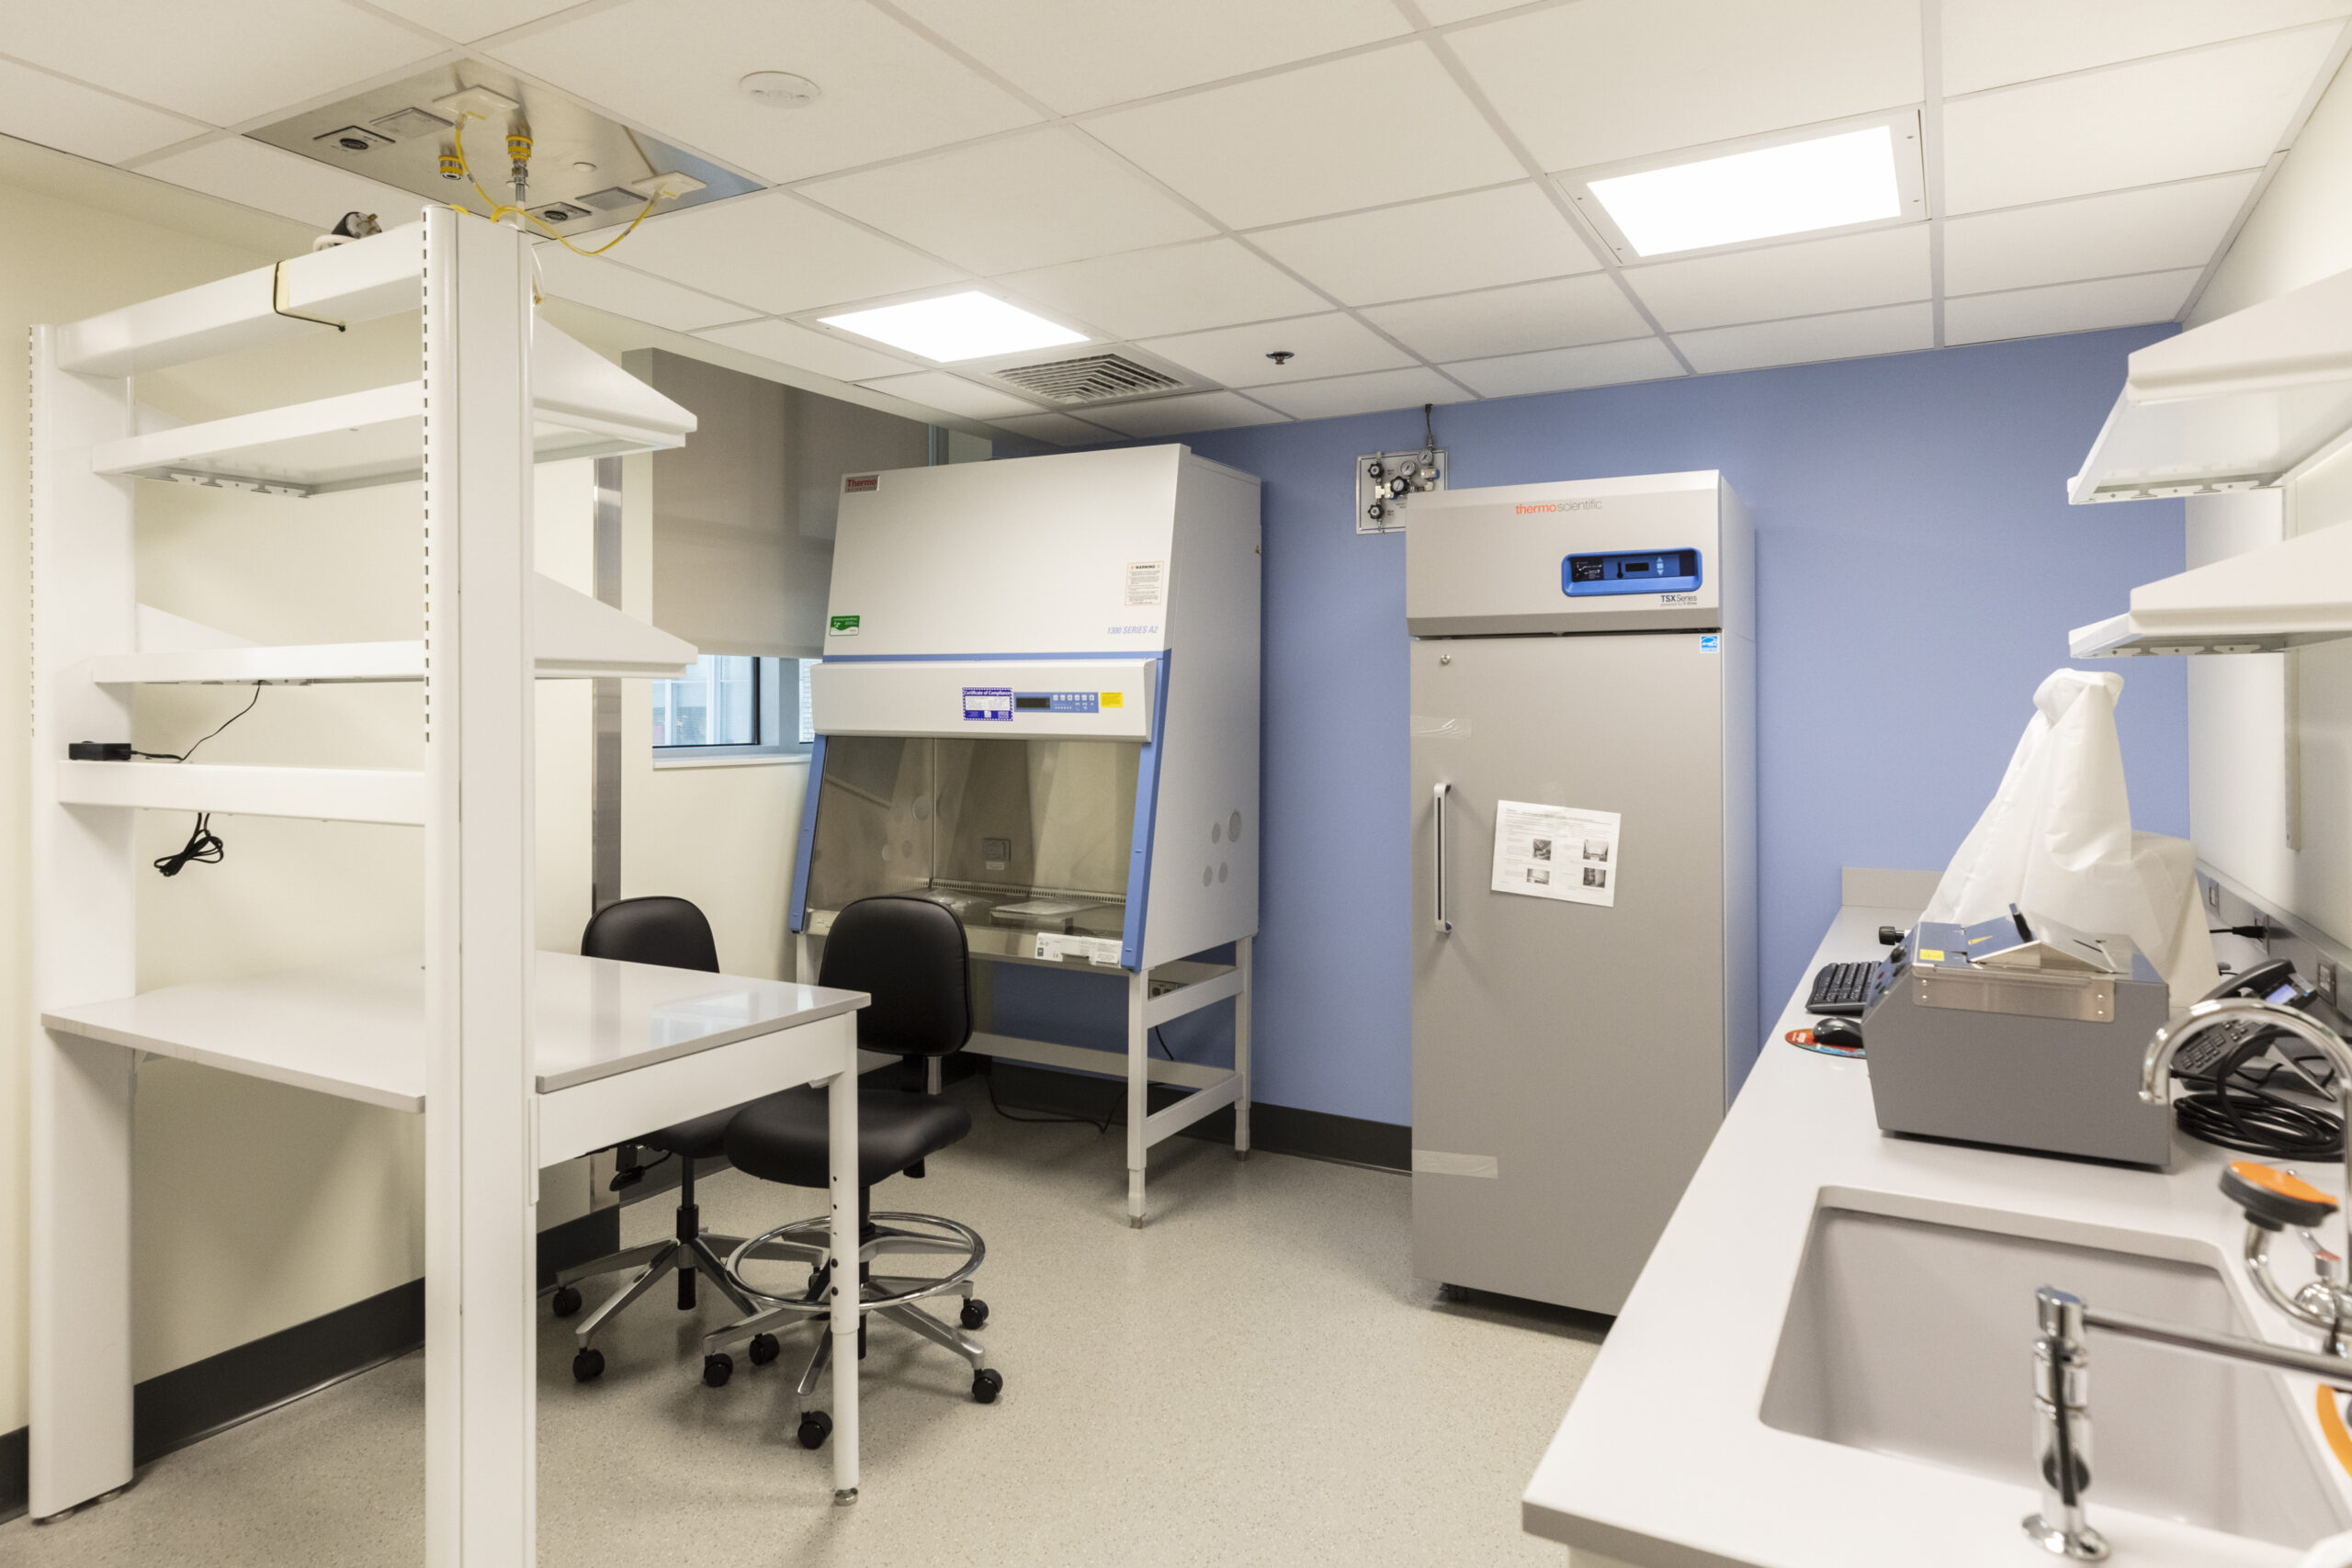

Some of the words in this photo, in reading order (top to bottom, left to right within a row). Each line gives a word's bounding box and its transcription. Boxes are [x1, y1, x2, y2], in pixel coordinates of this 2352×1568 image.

[847, 479, 877, 487] Thermo
[1515, 503, 1557, 514] thermo
[1557, 499, 1602, 512] scientific
[1661, 594, 1676, 603] TSX
[1676, 593, 1697, 602] Series
[1123, 626, 1148, 634] SERIES
[1148, 626, 1159, 634] A2
